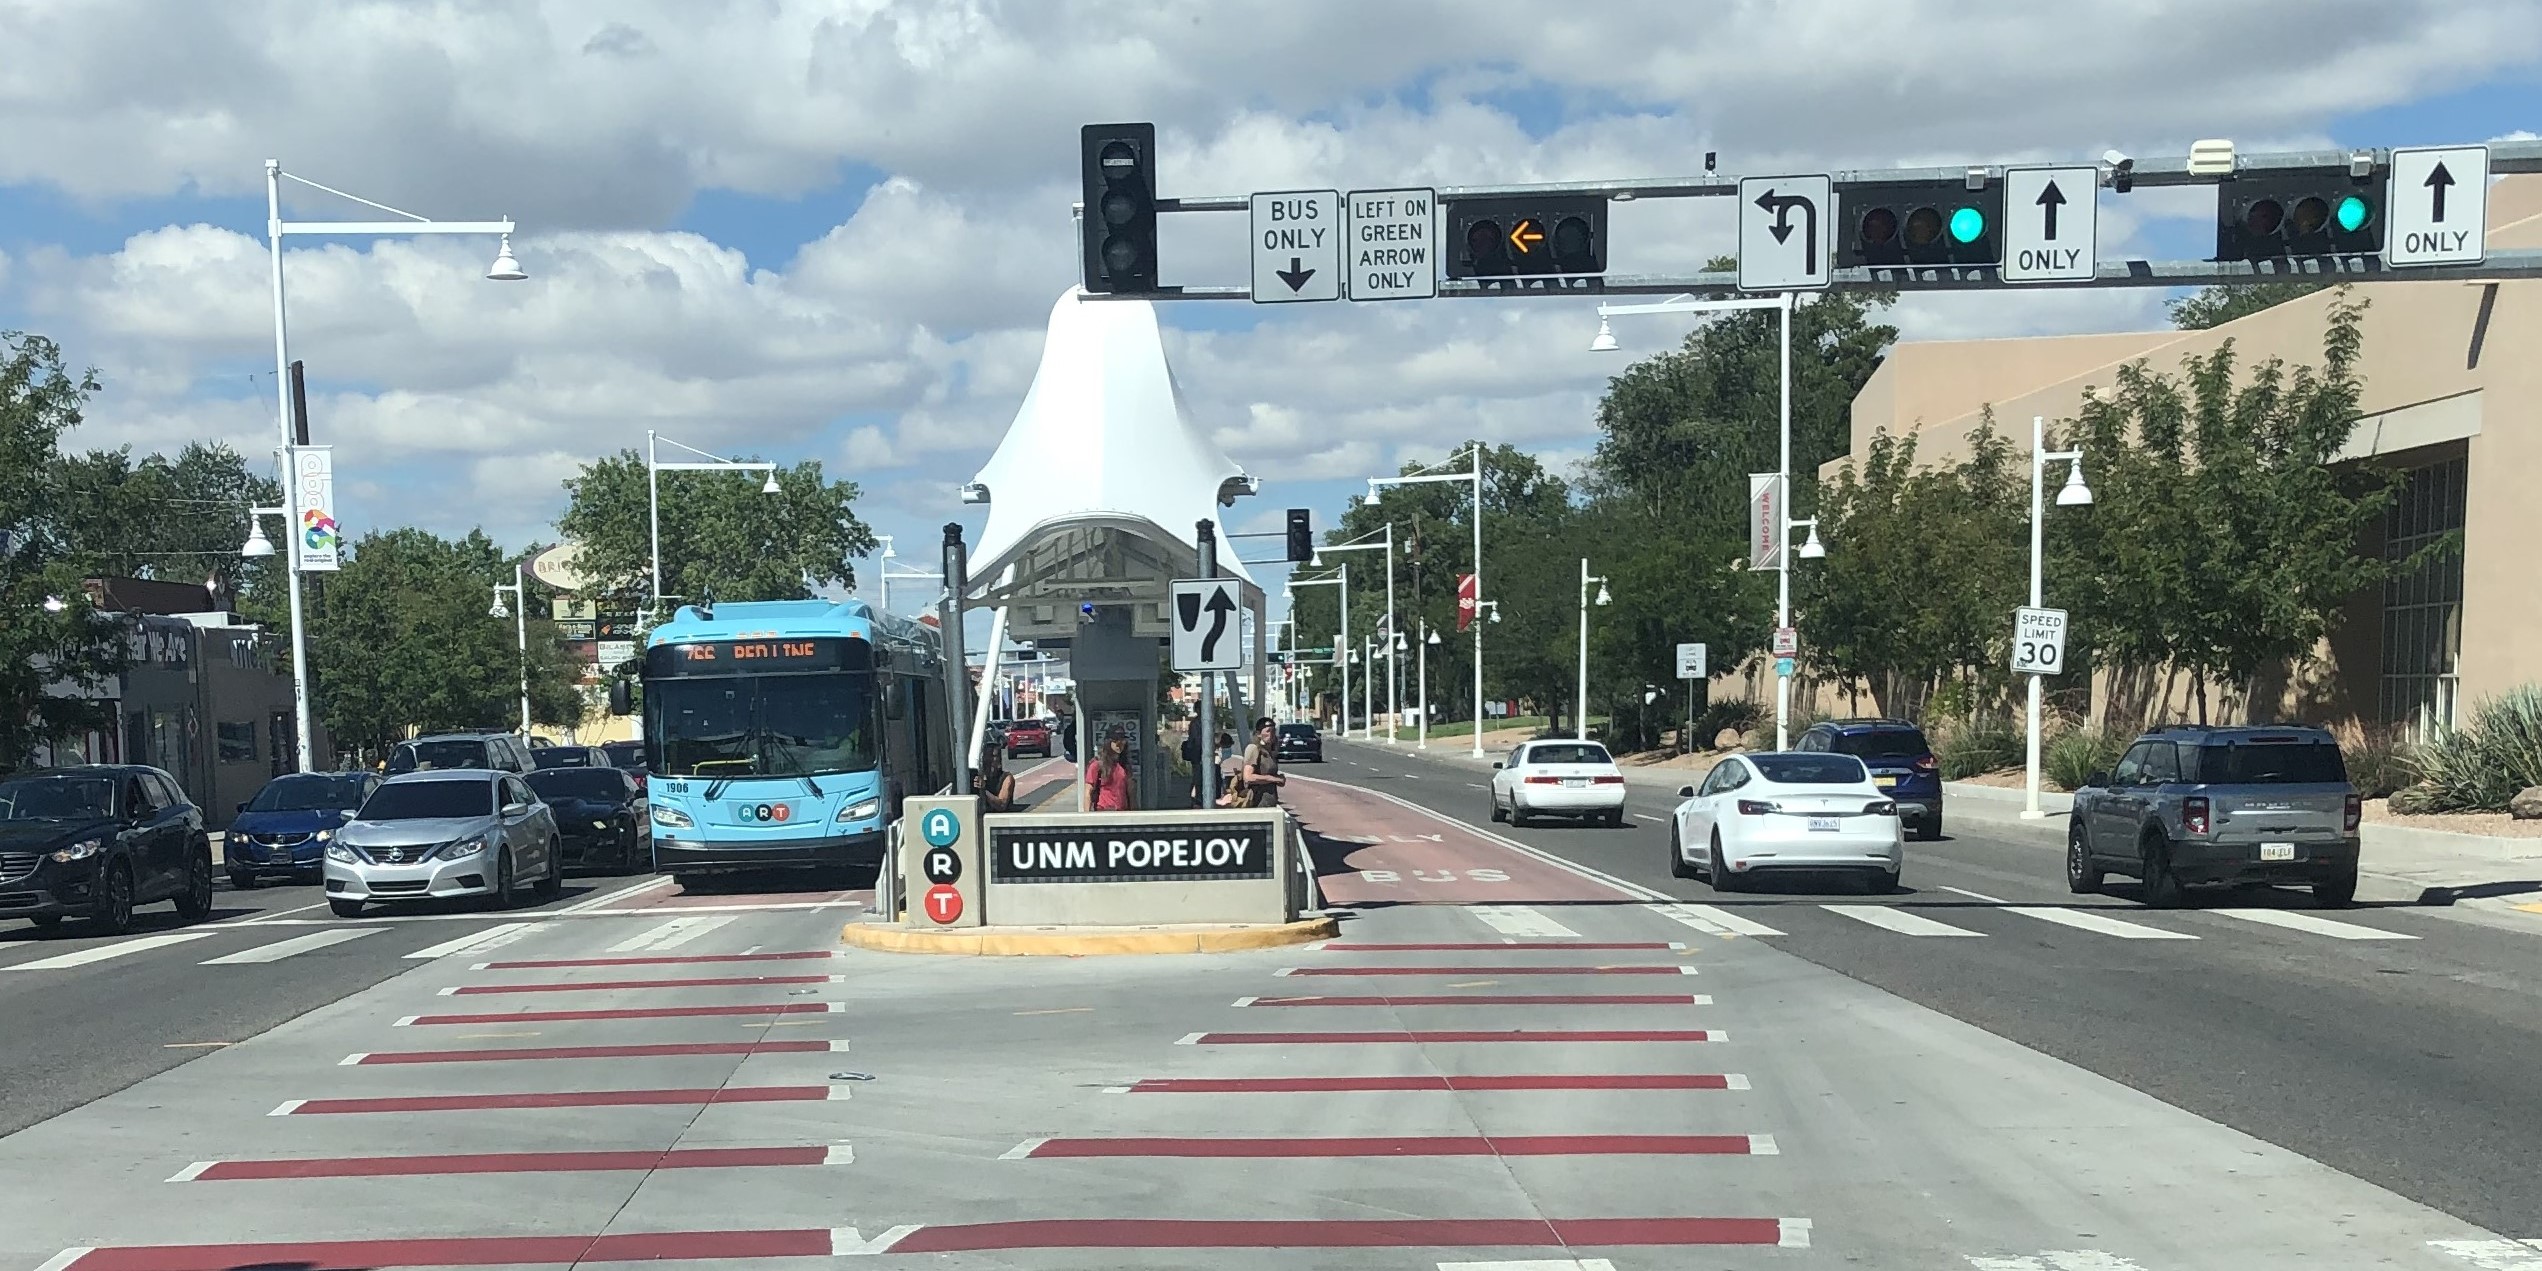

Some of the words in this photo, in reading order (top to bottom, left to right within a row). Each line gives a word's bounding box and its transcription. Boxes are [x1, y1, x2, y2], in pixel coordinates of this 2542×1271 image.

[1271, 199, 1318, 221] BUS
[1356, 200, 1395, 218] LEFT
[1405, 199, 1426, 216] ON
[1264, 228, 1326, 250] ONLY
[1361, 223, 1422, 242] GREEN
[2405, 230, 2469, 253] ONLY
[1359, 248, 1426, 266] ARROW
[2018, 248, 2081, 270] ONLY
[1368, 271, 1414, 289] ONLY
[1762, 492, 1770, 551] WELCOME
[2022, 614, 2062, 627] SPEED
[2024, 628, 2056, 640] LIMIT
[147, 631, 165, 661] We
[165, 632, 187, 662] Are
[2019, 642, 2056, 665] 30
[666, 782, 689, 794] 1906
[740, 805, 788, 820] ART
[1011, 840, 1097, 869] UNM
[1108, 838, 1250, 868] POPEJOY
[1361, 868, 1511, 883] BUS
